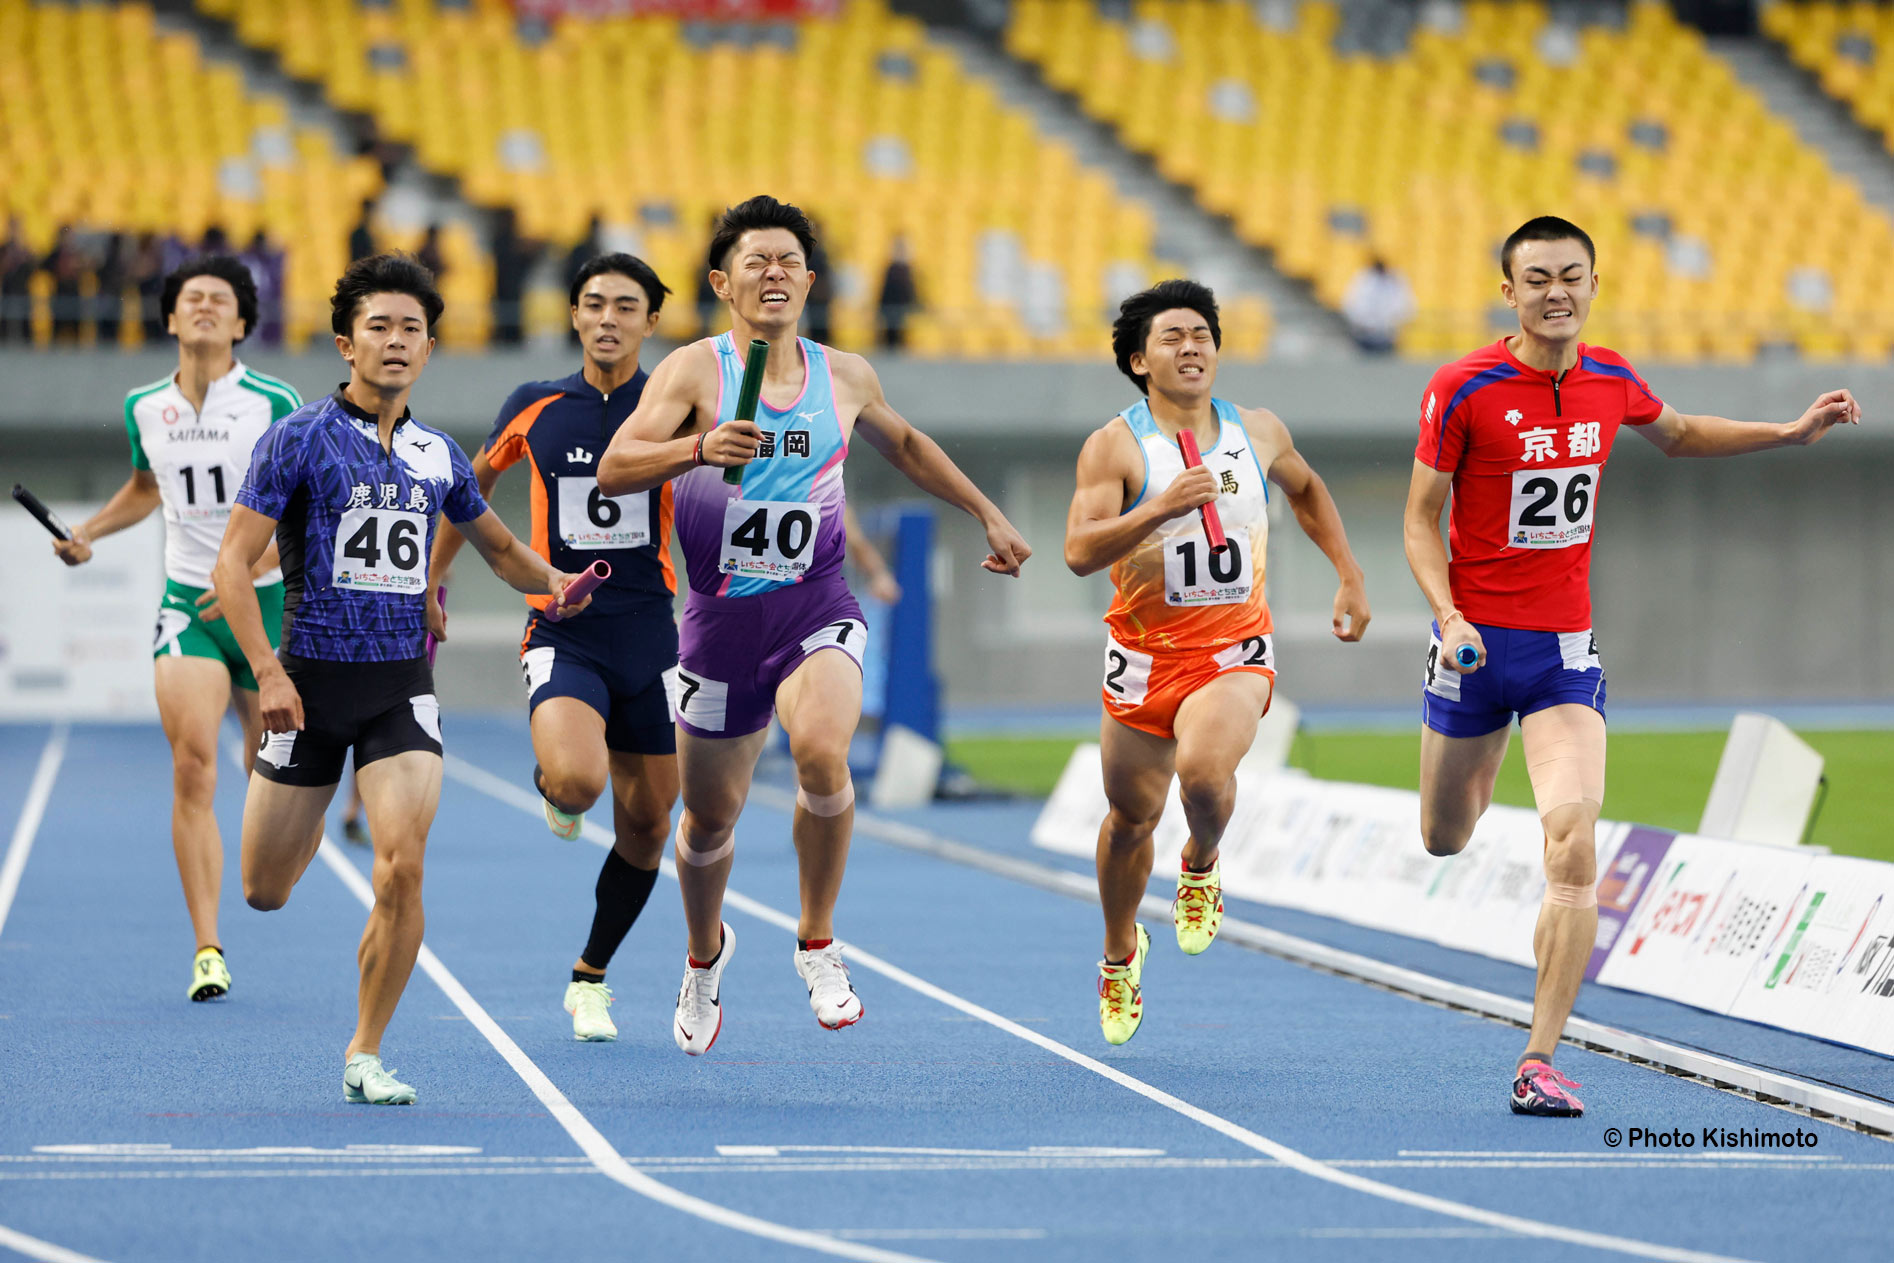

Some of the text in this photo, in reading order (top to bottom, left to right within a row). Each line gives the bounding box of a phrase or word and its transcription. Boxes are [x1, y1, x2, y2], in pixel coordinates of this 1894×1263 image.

[167, 429, 230, 443] SAITAMA
[1518, 421, 1601, 462] 京都
[179, 465, 226, 505] 11
[345, 482, 430, 513] 鹿児島
[587, 484, 621, 528] 6
[1518, 473, 1591, 524] 26
[344, 516, 419, 571] 46
[730, 508, 812, 559] 40
[1176, 537, 1242, 587] 10
[830, 622, 853, 645] 7
[1242, 636, 1266, 665] 2
[678, 671, 700, 713] 7
[1106, 649, 1128, 693] 2
